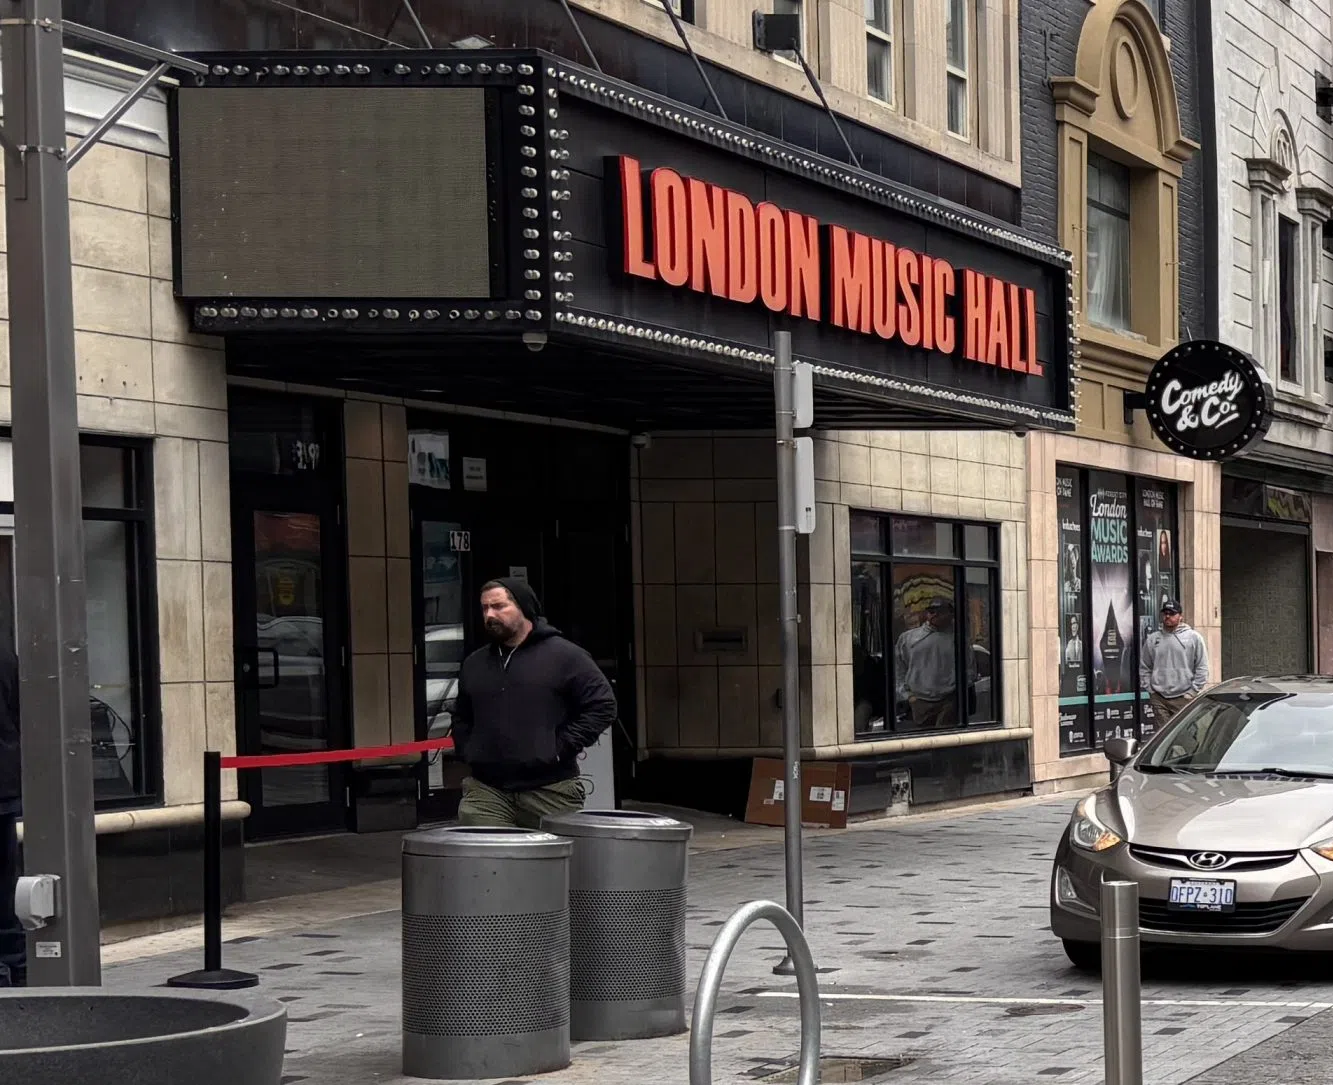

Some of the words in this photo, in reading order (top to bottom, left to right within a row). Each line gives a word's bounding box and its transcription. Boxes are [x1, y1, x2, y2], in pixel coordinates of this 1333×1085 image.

[619, 154, 821, 321] LONDON
[829, 224, 956, 354] MUSIC
[963, 268, 1044, 377] HALL
[1161, 370, 1244, 415] Comedy
[1176, 405, 1199, 431] &
[1201, 396, 1237, 426] Co.
[1089, 493, 1127, 519] London
[450, 531, 470, 550] 178
[1091, 518, 1128, 544] MUSIC
[1091, 542, 1129, 564] AWARDS
